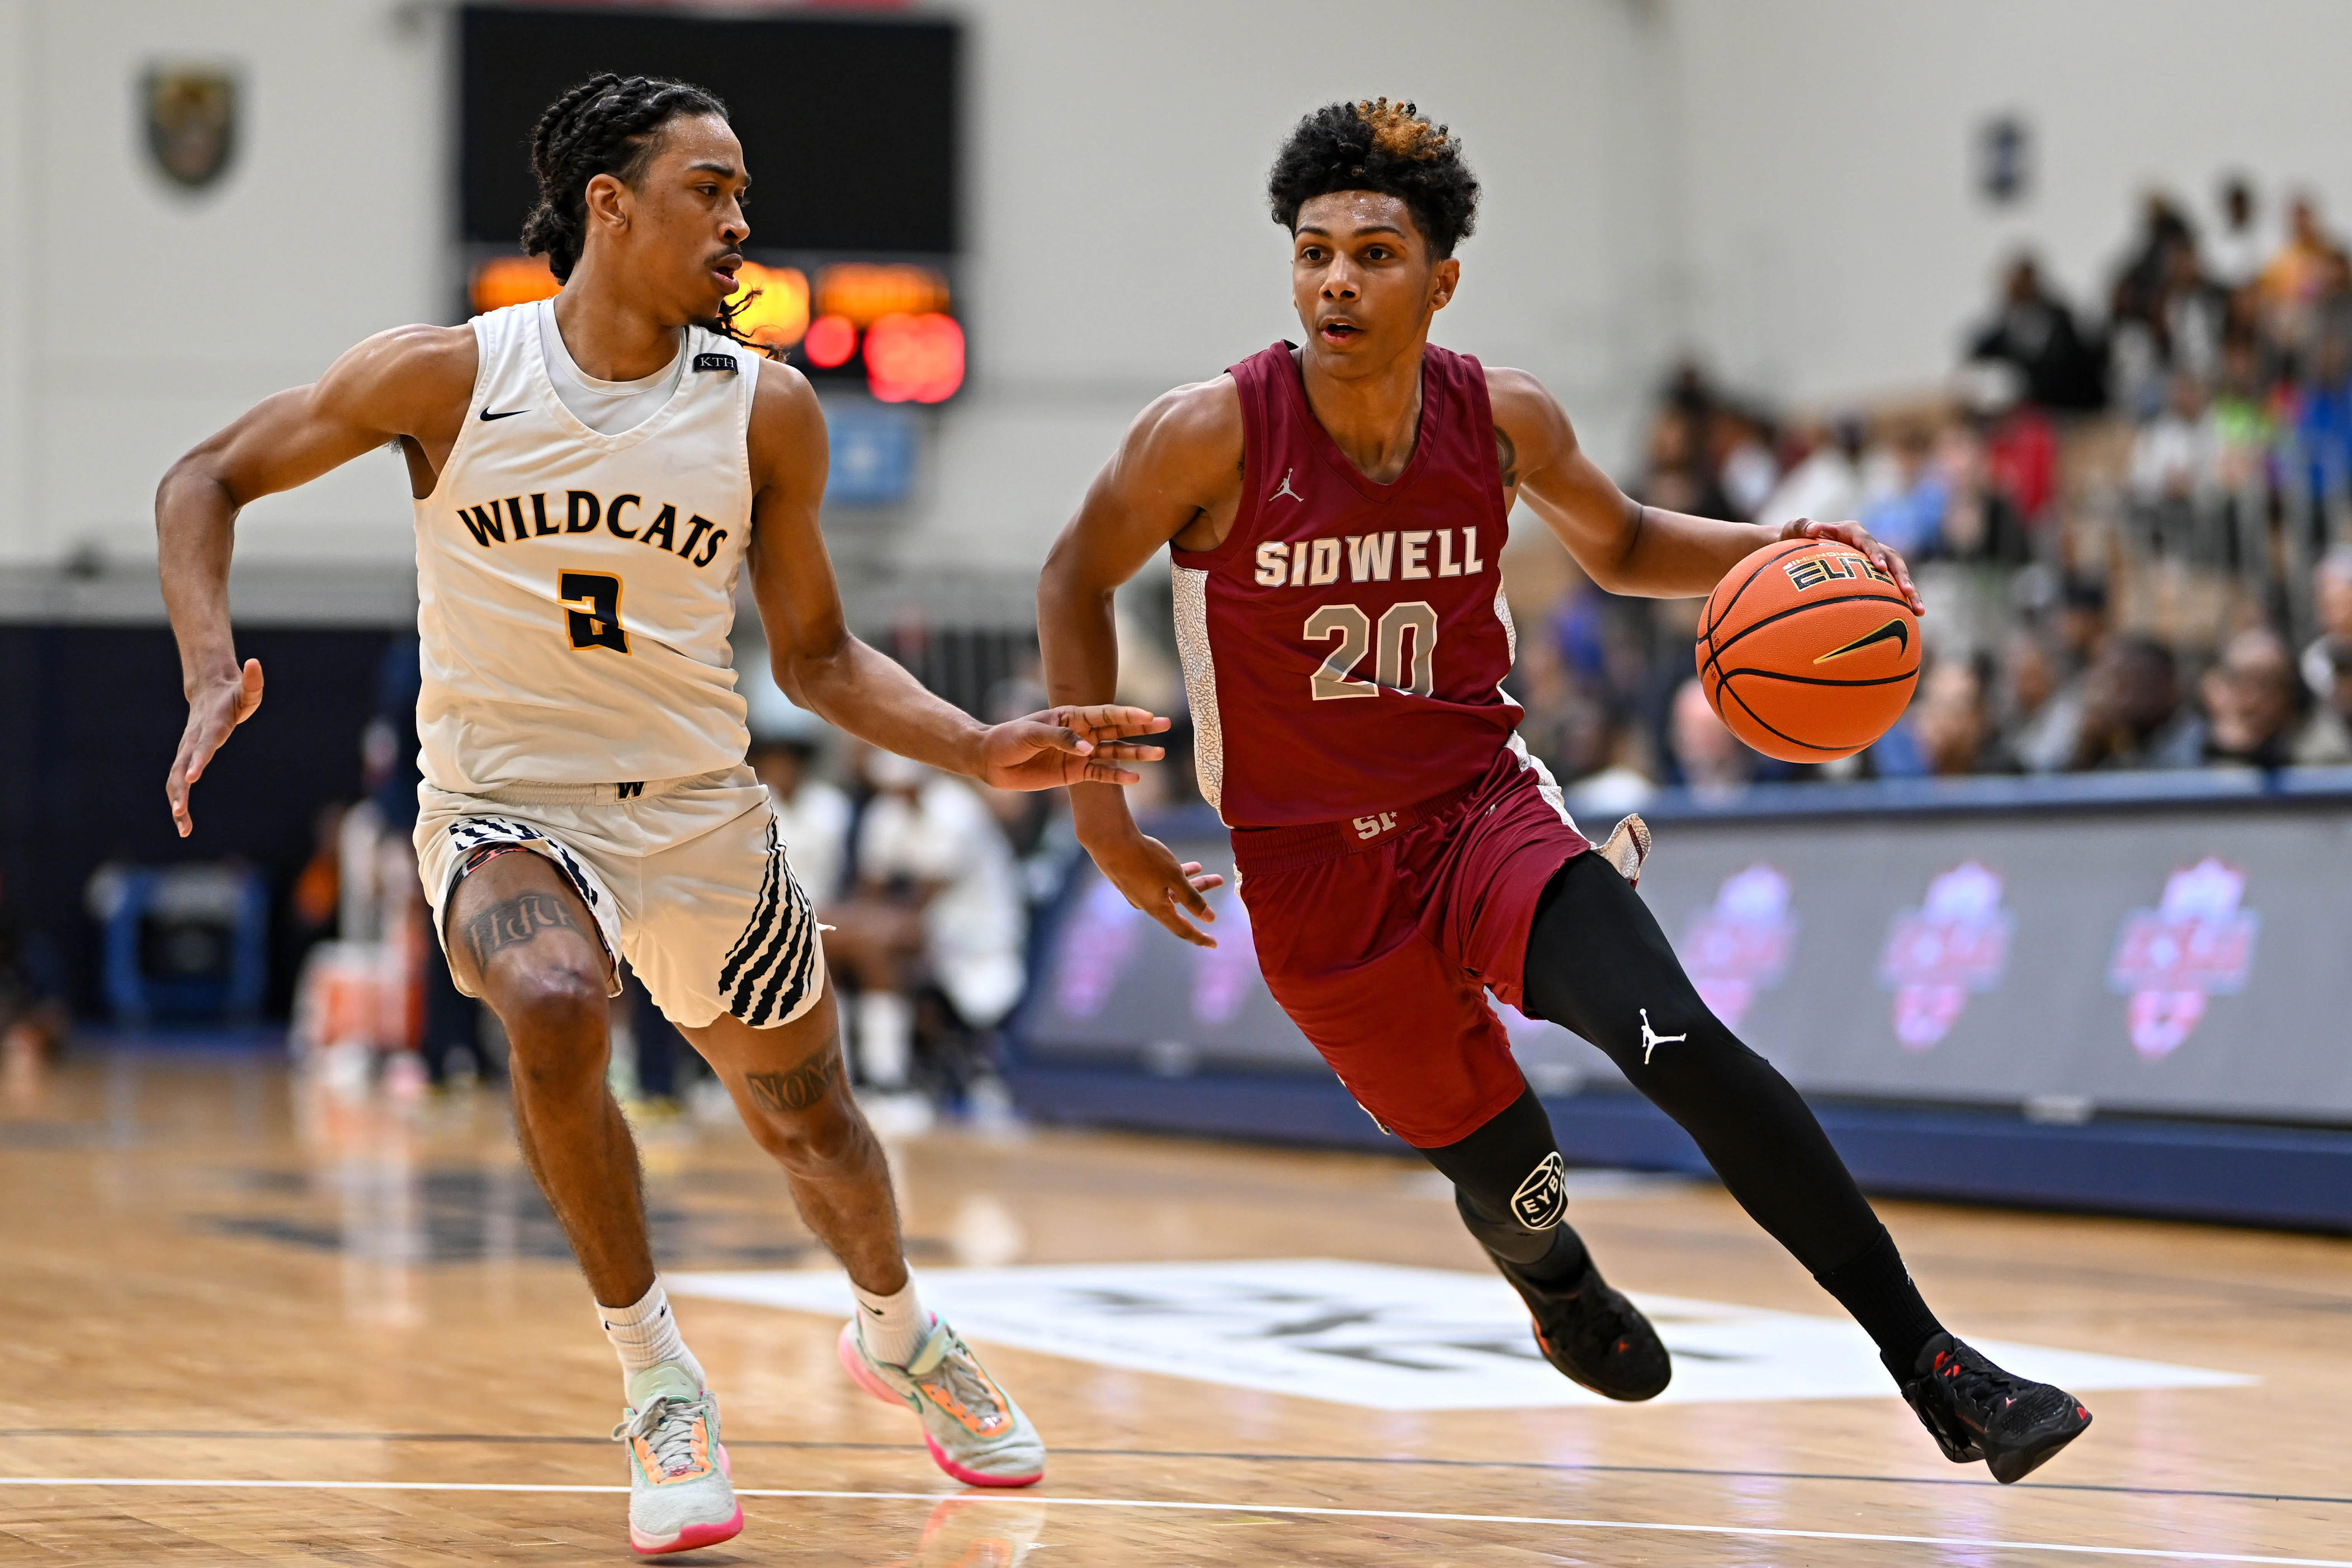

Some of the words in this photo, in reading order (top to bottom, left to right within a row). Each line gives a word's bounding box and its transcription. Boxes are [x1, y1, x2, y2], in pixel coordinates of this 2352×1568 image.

[700, 357, 735, 369] KTH
[456, 489, 728, 569] WILDCATS
[1255, 526, 1484, 587] SIDWELL
[1303, 601, 1438, 701] 20
[615, 781, 648, 801] W
